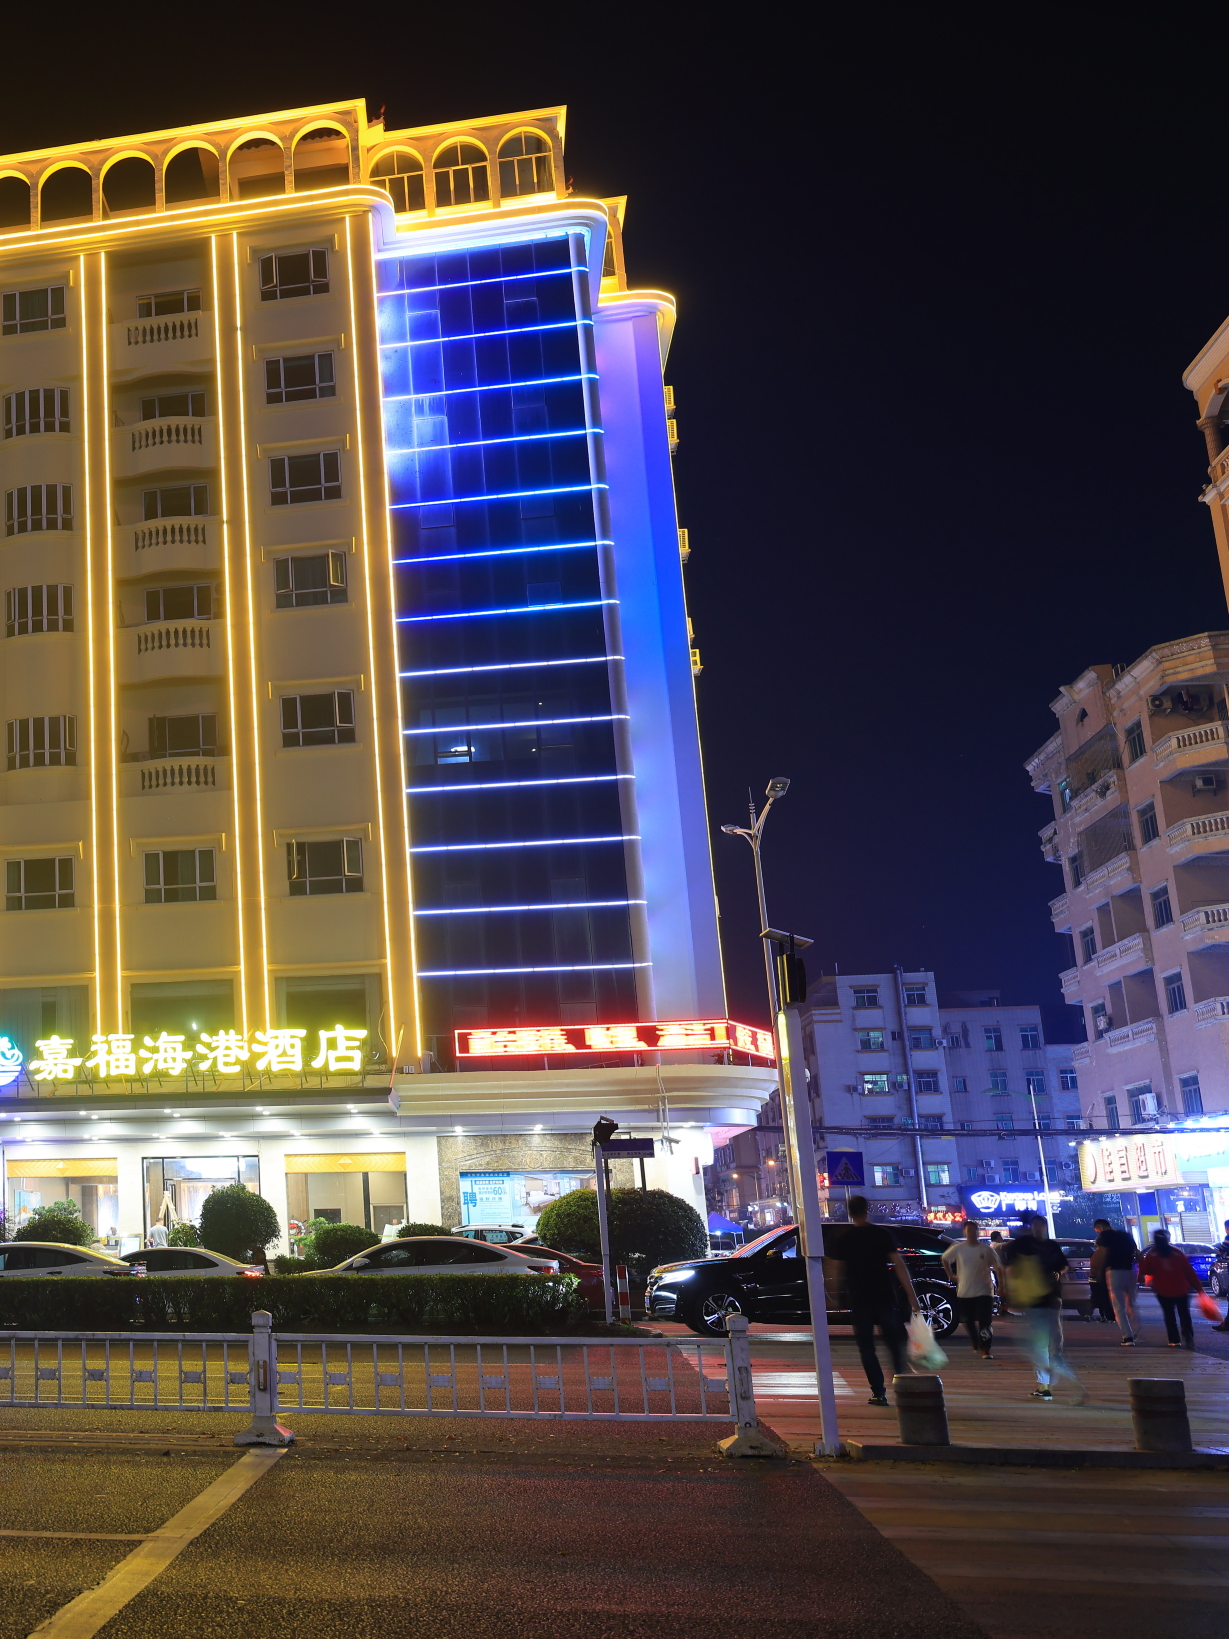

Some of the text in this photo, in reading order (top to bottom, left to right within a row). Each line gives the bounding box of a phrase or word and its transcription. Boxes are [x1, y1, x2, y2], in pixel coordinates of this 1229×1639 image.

[29, 1023, 369, 1081] 嘉福海港酒店
[462, 1191, 477, 1207] 聘
